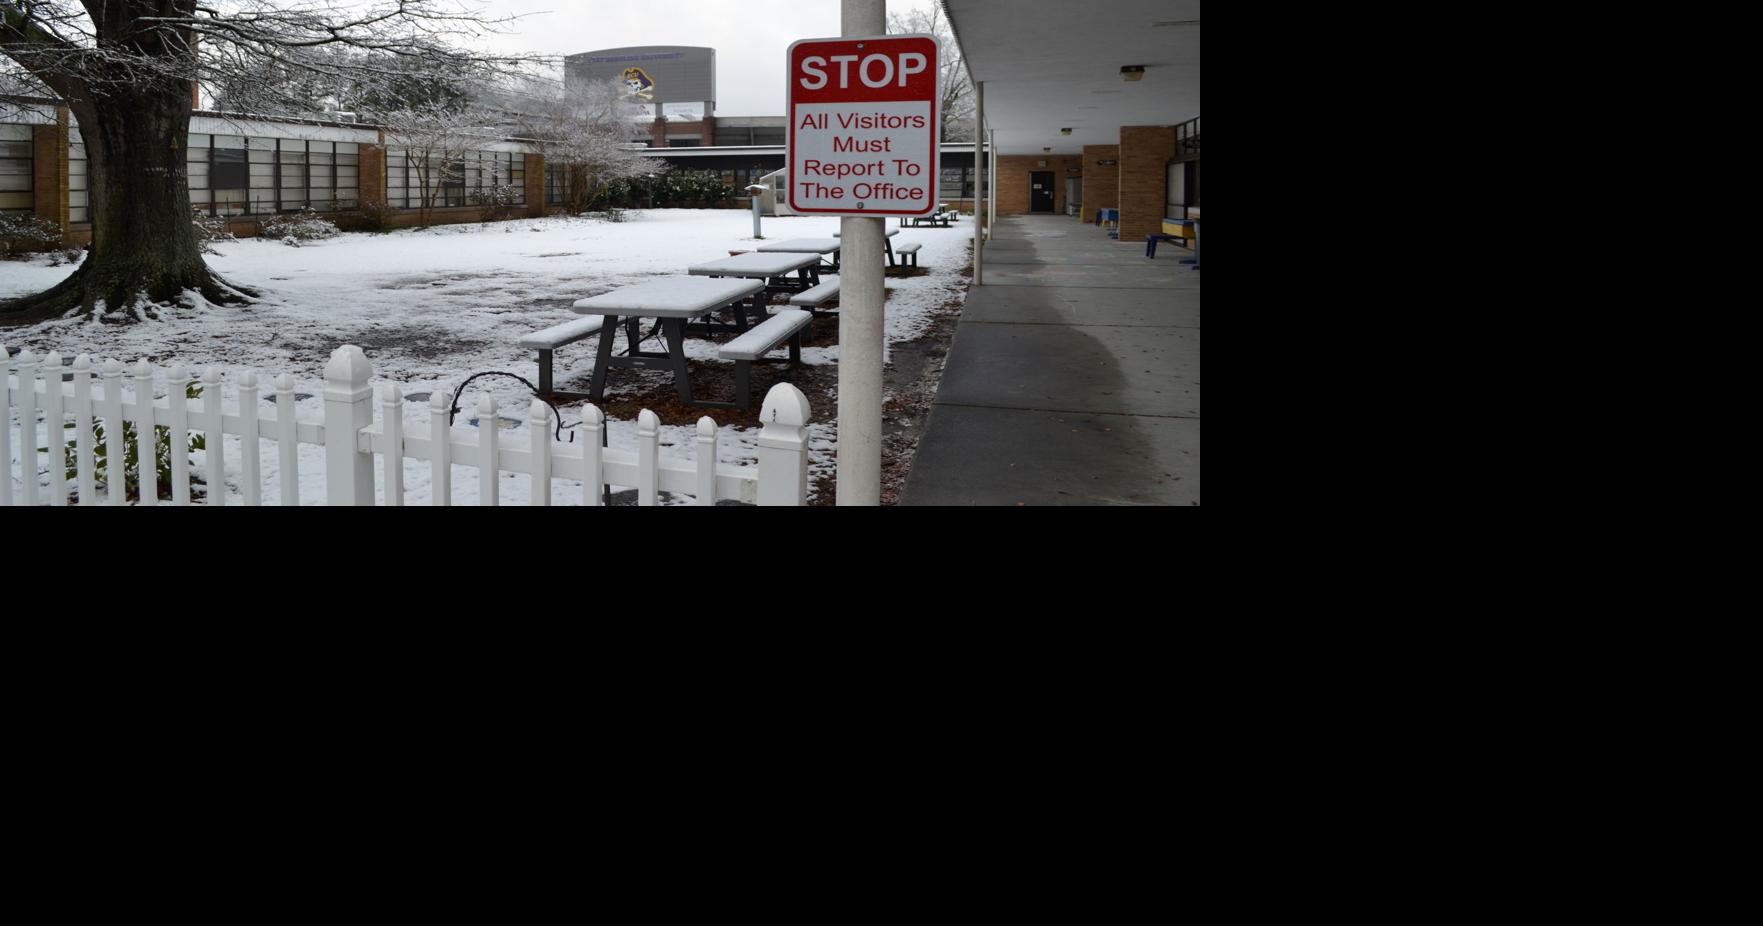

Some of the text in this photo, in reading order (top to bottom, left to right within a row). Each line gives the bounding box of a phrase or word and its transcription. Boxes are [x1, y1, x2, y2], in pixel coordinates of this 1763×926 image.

[800, 53, 927, 90] STOP
[800, 112, 925, 130] All Visitors
[833, 136, 891, 152] Must
[804, 159, 921, 180] Report To
[800, 182, 924, 200] The Office
